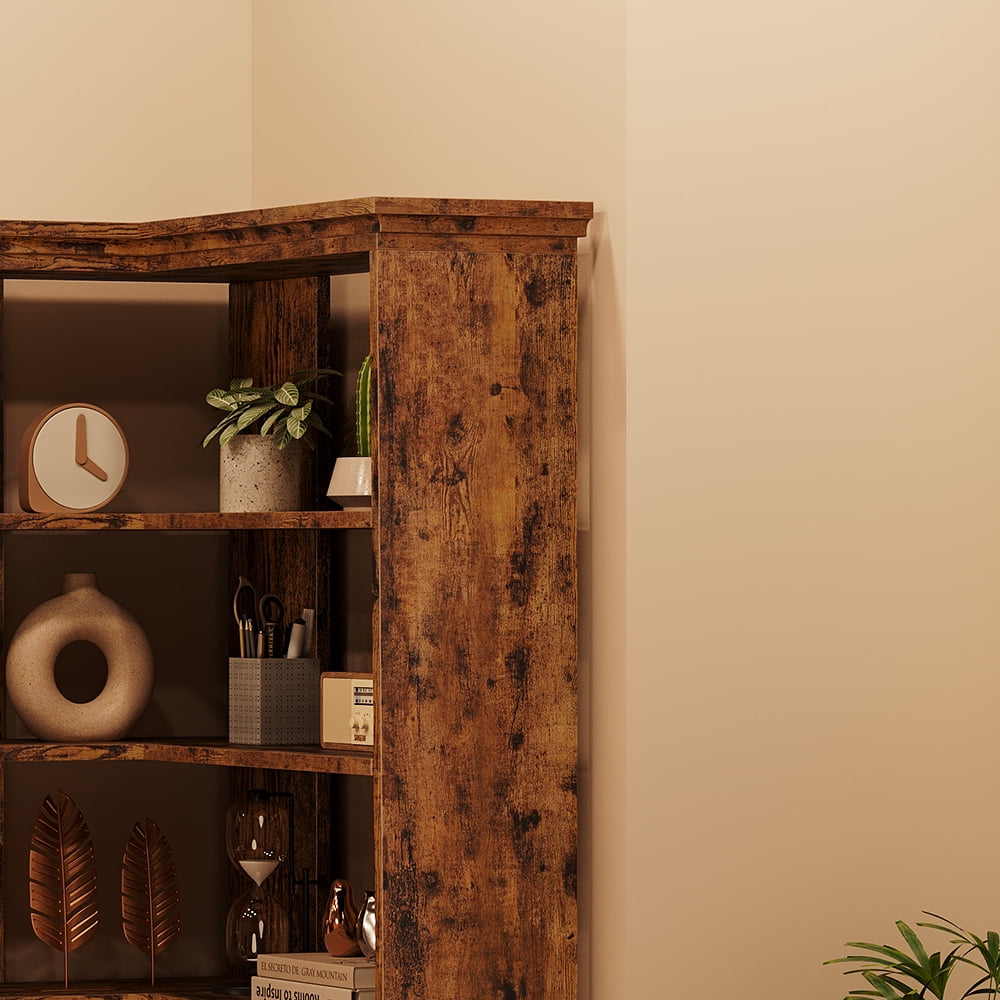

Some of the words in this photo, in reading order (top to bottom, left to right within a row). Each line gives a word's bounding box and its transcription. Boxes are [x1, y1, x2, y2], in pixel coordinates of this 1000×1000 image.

[261, 961, 267, 971] EL
[268, 962, 291, 974] SECRETO
[292, 965, 299, 975] DE
[301, 967, 316, 977] GRAY
[316, 969, 348, 981] MOUNTAIN
